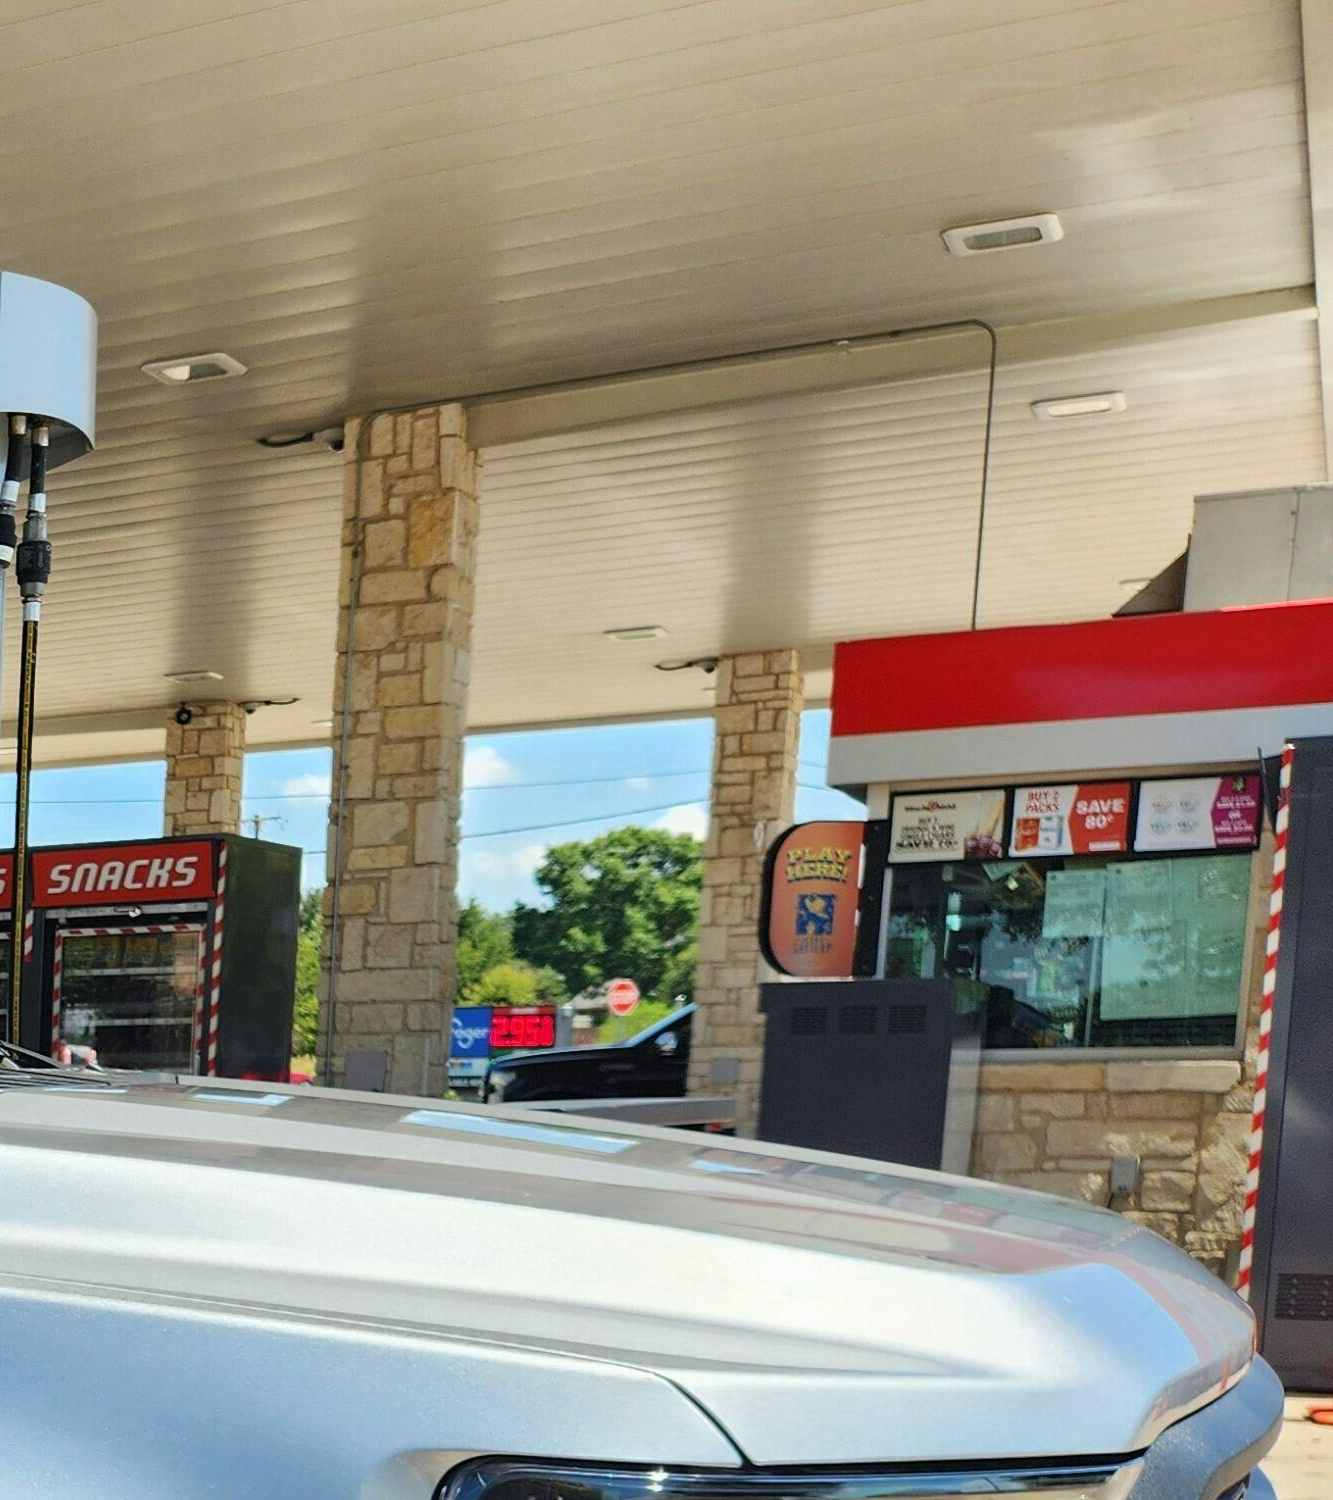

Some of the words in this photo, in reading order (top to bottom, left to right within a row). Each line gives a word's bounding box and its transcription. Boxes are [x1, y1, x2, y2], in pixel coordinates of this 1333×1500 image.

[1028, 791, 1049, 801] BUY
[1026, 802, 1060, 813] PACKS
[1076, 798, 1125, 815] SAVE
[788, 849, 852, 862] PLAY
[47, 857, 199, 895] SNACKS
